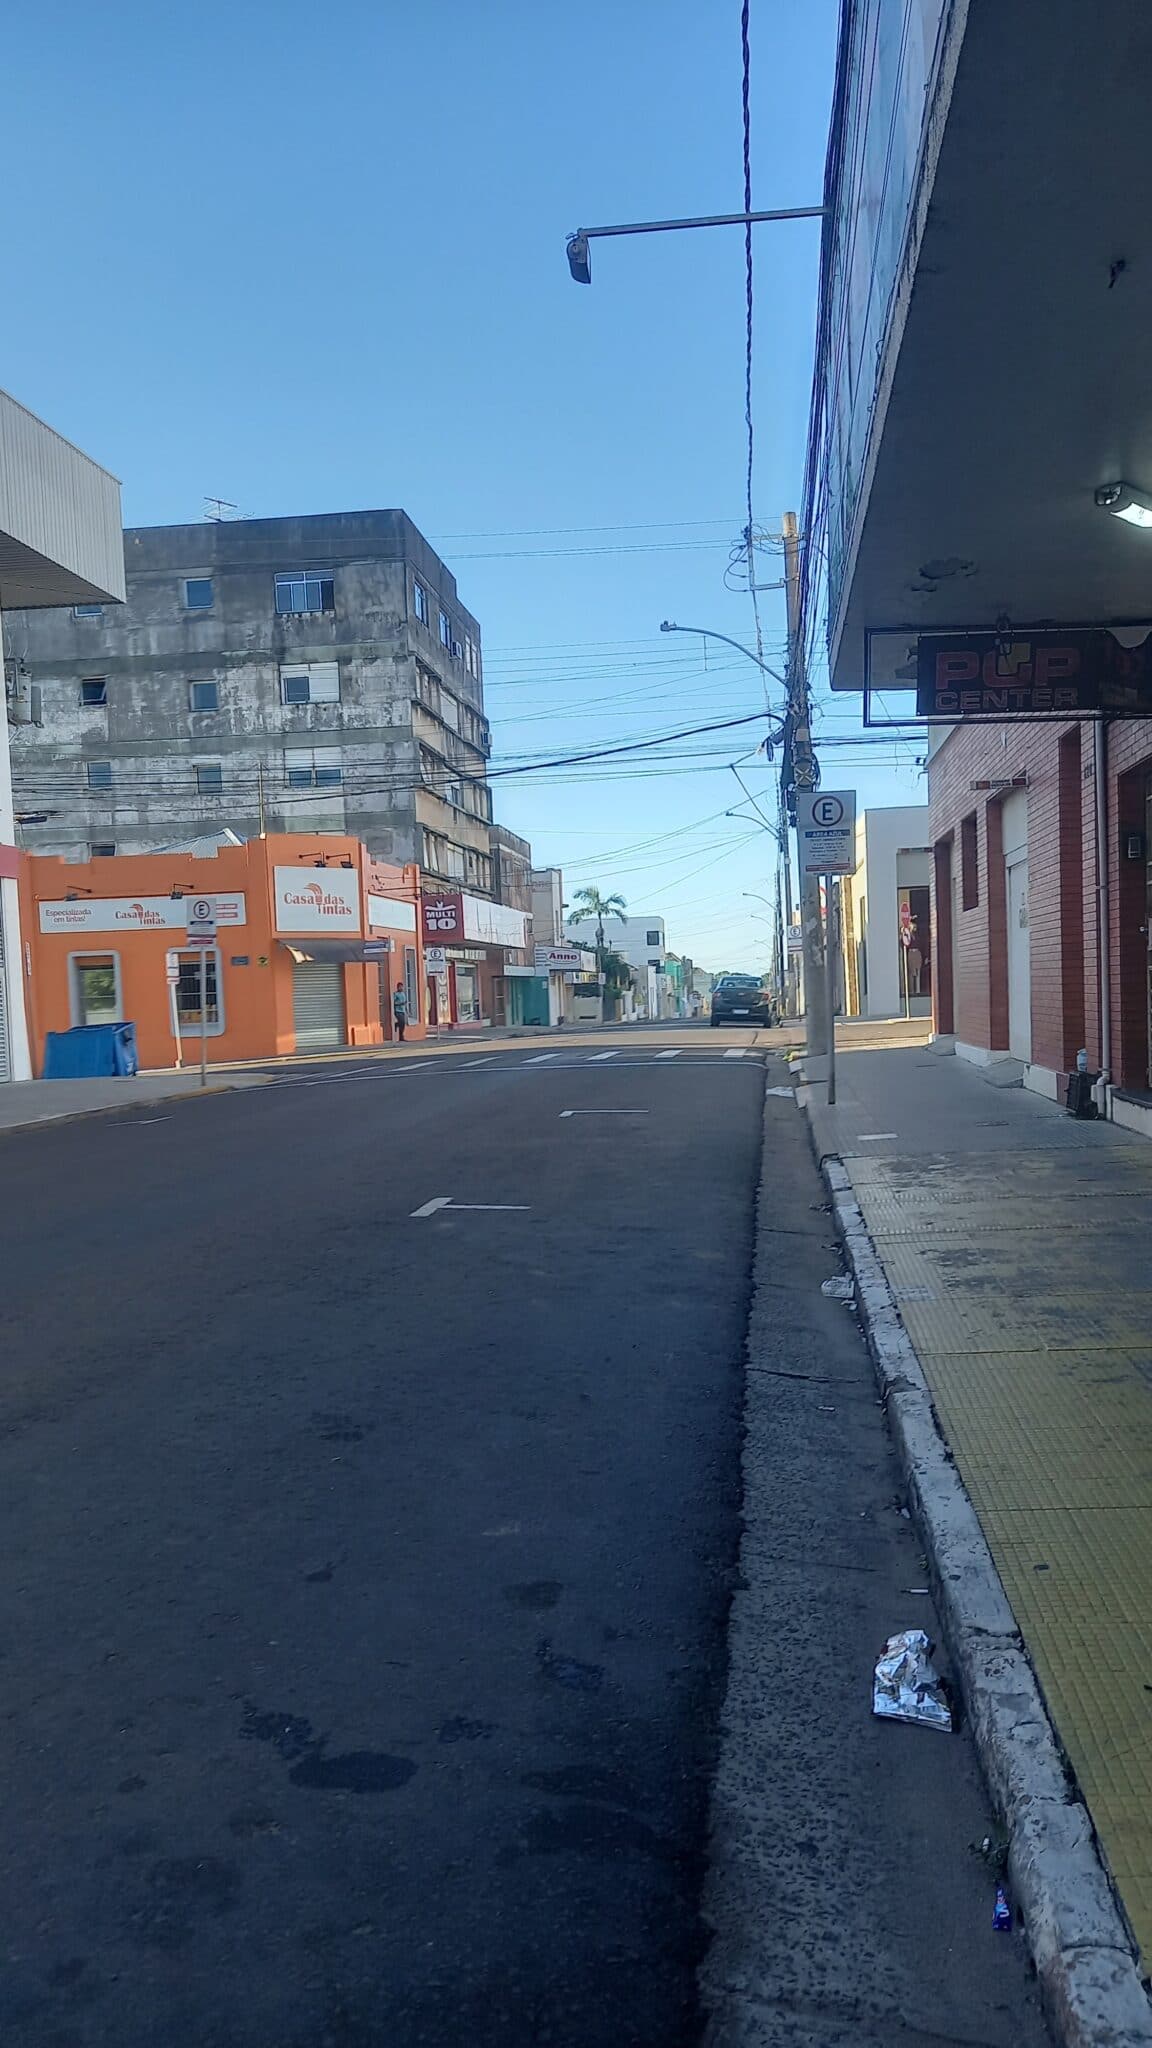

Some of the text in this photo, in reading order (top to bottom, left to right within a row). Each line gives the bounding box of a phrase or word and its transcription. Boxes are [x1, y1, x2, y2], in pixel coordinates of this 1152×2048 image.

[935, 687, 1079, 710] CENTER
[822, 802, 833, 821] E
[284, 892, 345, 904] Casa das
[45, 908, 92, 918] Especializada
[115, 909, 160, 920] Casa das
[198, 904, 205, 916] E
[317, 904, 352, 915] Tintas
[426, 910, 456, 919] MULTI
[426, 918, 457, 931] 10
[549, 952, 578, 960] Anno
